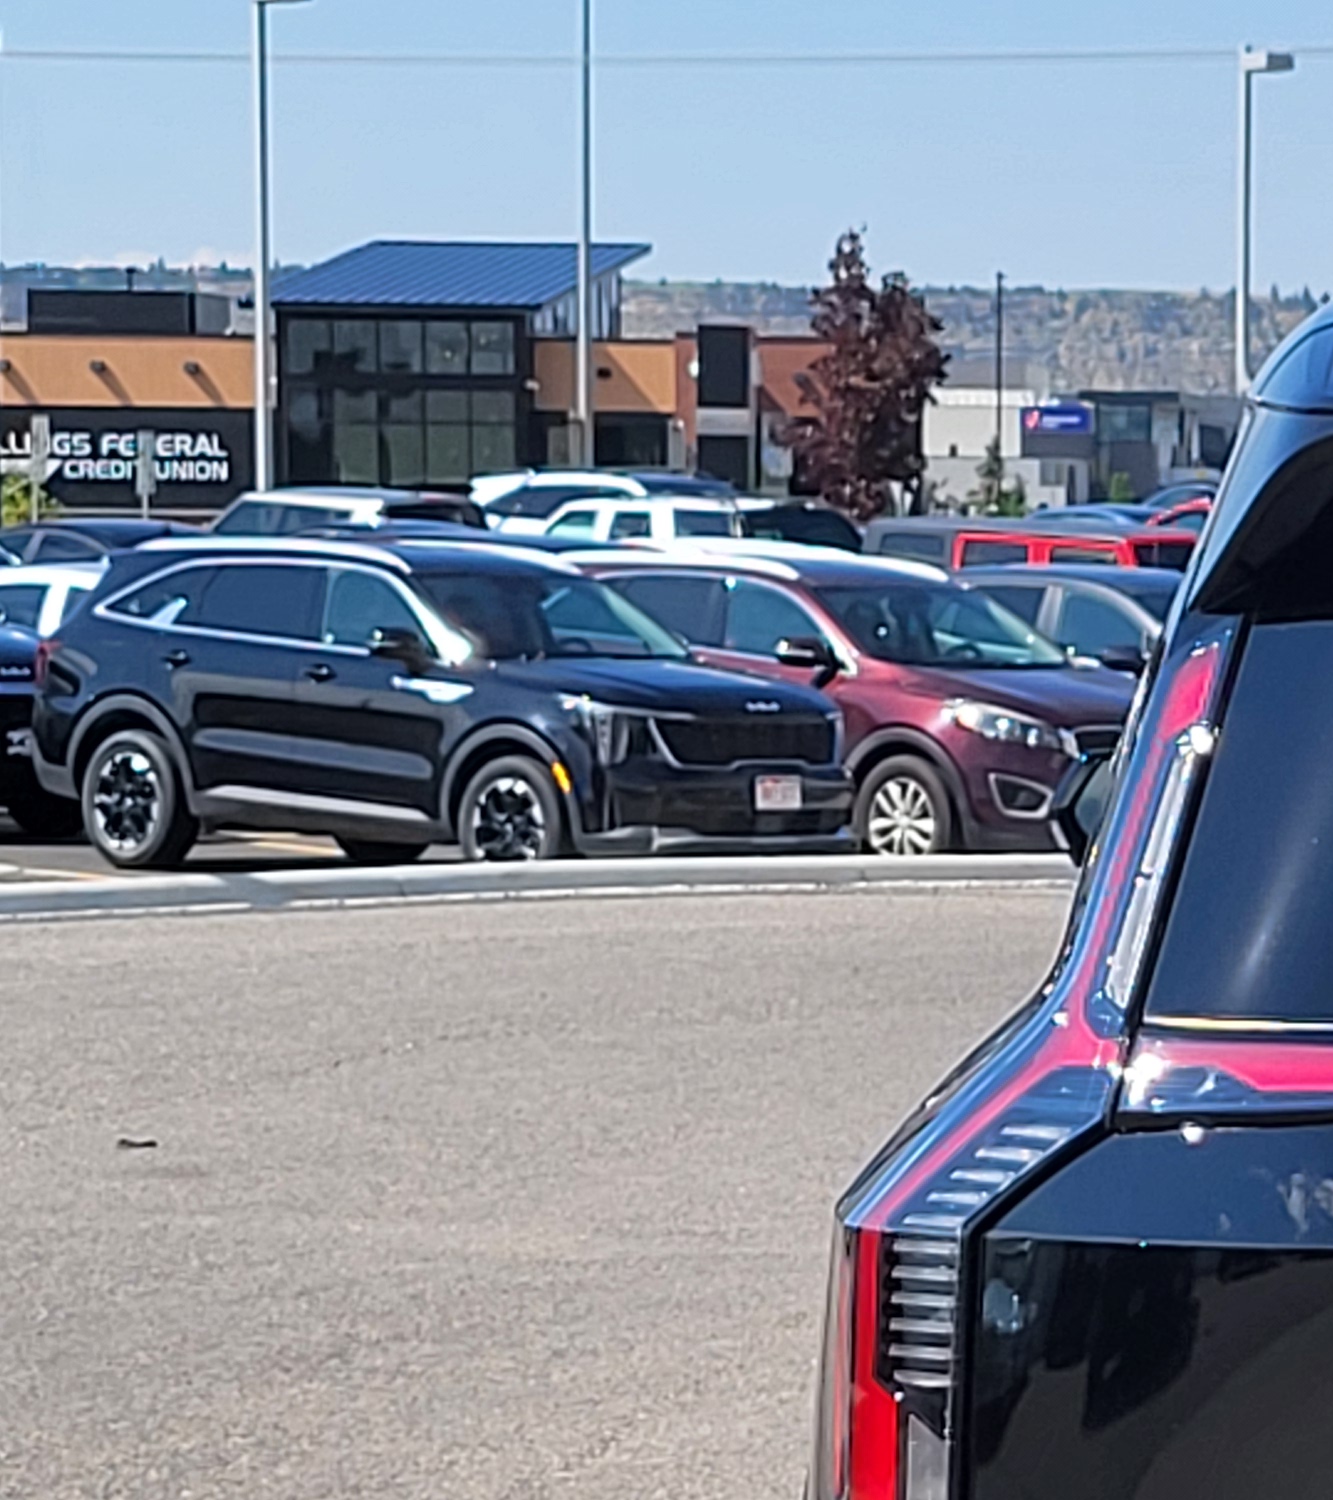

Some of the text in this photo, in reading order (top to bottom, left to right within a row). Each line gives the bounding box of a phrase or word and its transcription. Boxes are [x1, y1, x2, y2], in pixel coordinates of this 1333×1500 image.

[0, 431, 228, 457] LIGS FEERAL
[154, 460, 229, 481] UNION
